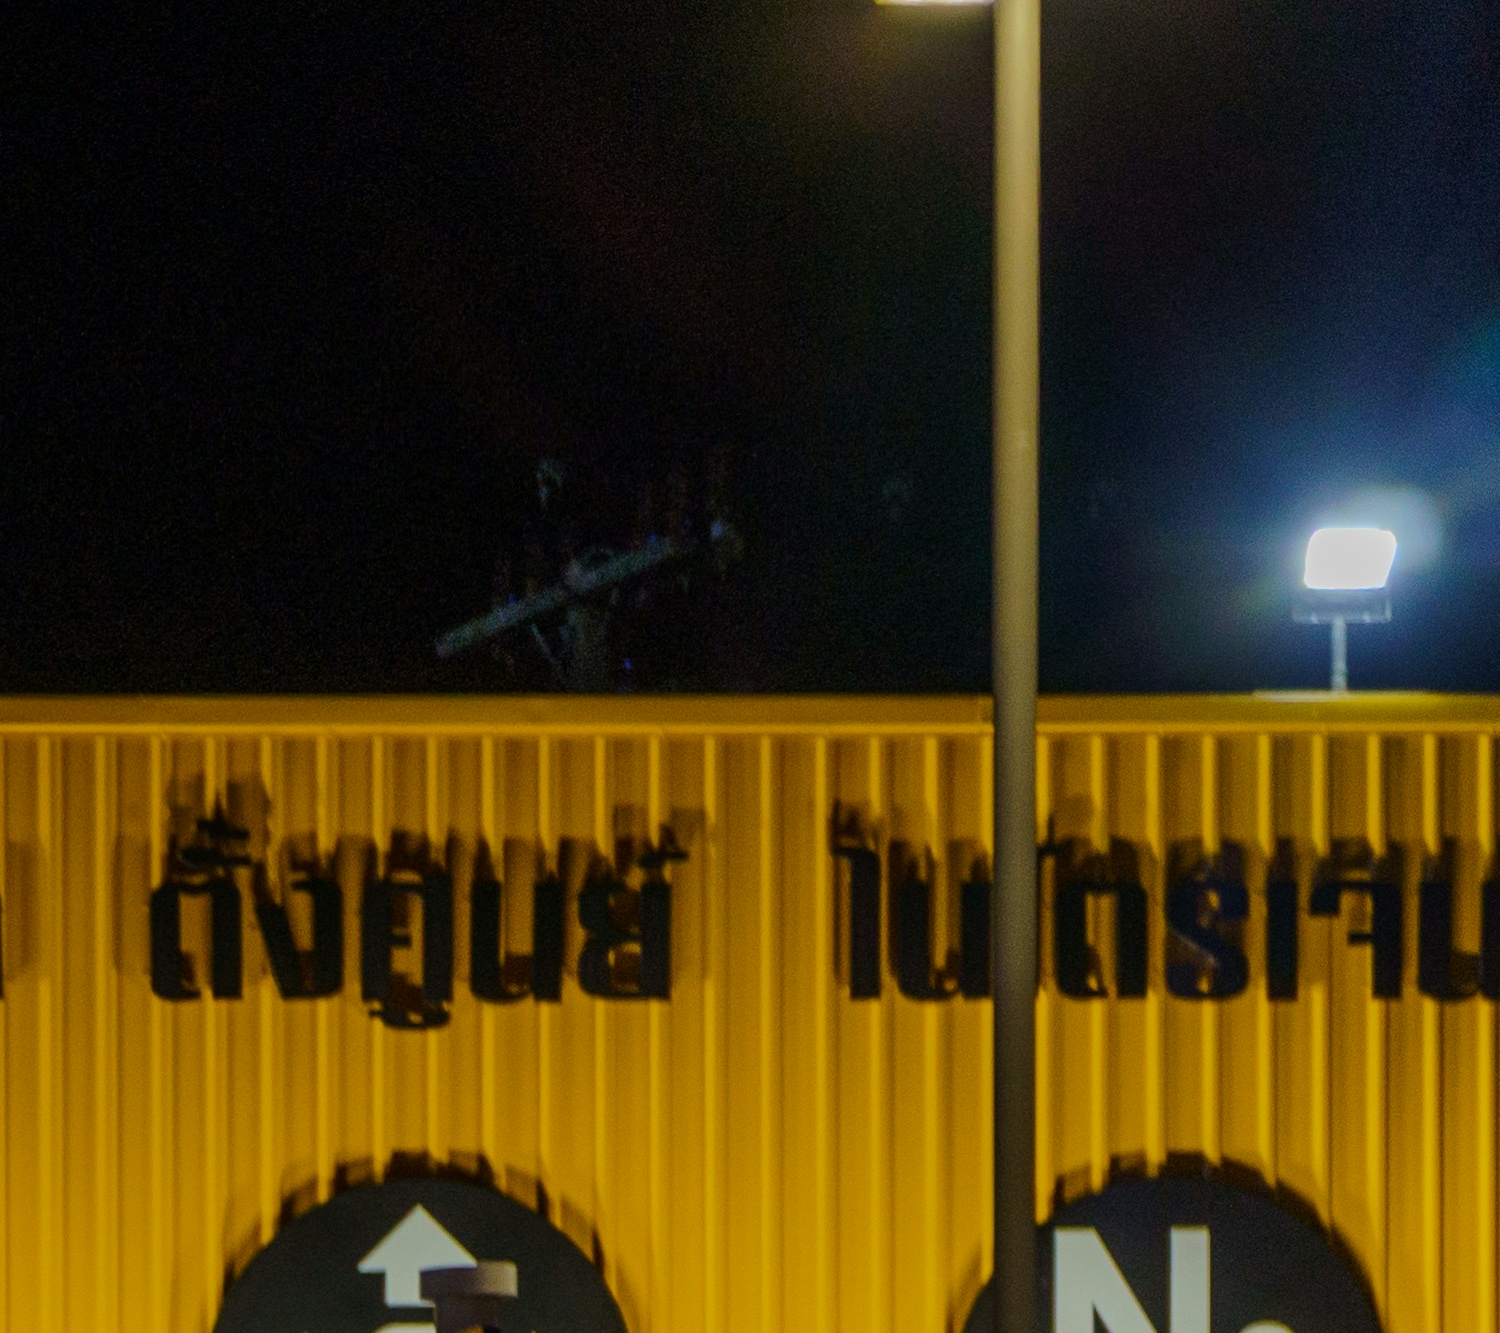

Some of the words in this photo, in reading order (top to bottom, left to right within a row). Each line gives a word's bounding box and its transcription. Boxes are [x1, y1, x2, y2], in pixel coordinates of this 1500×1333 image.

[150, 806, 688, 1029] ตั้งศูนย์
[834, 844, 1500, 1002] ไนตรเจน
